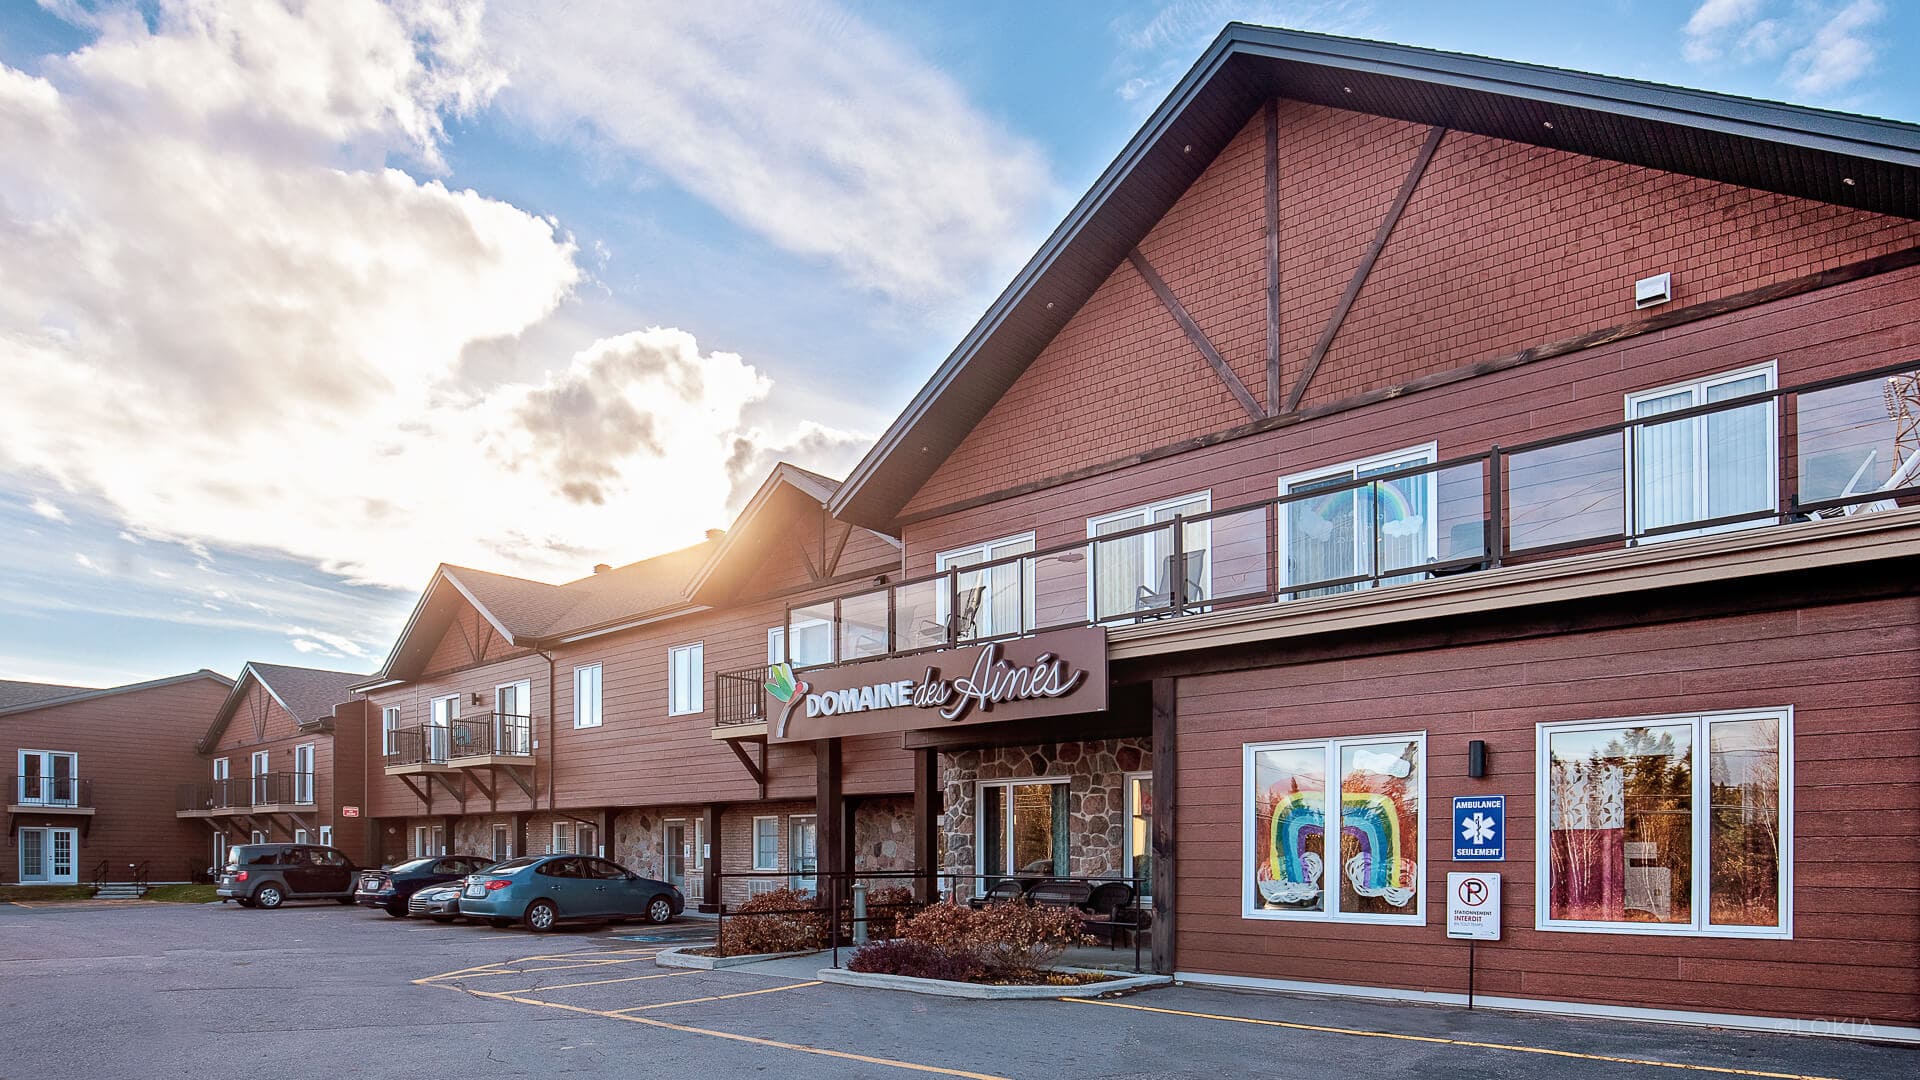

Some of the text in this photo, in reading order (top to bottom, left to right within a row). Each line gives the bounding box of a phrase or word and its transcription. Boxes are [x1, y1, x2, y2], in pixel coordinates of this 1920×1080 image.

[806, 643, 1081, 721] DOMAINE des Aînés
[1456, 800, 1501, 809] AMBULANCE
[1456, 848, 1500, 856] SEULEMENT
